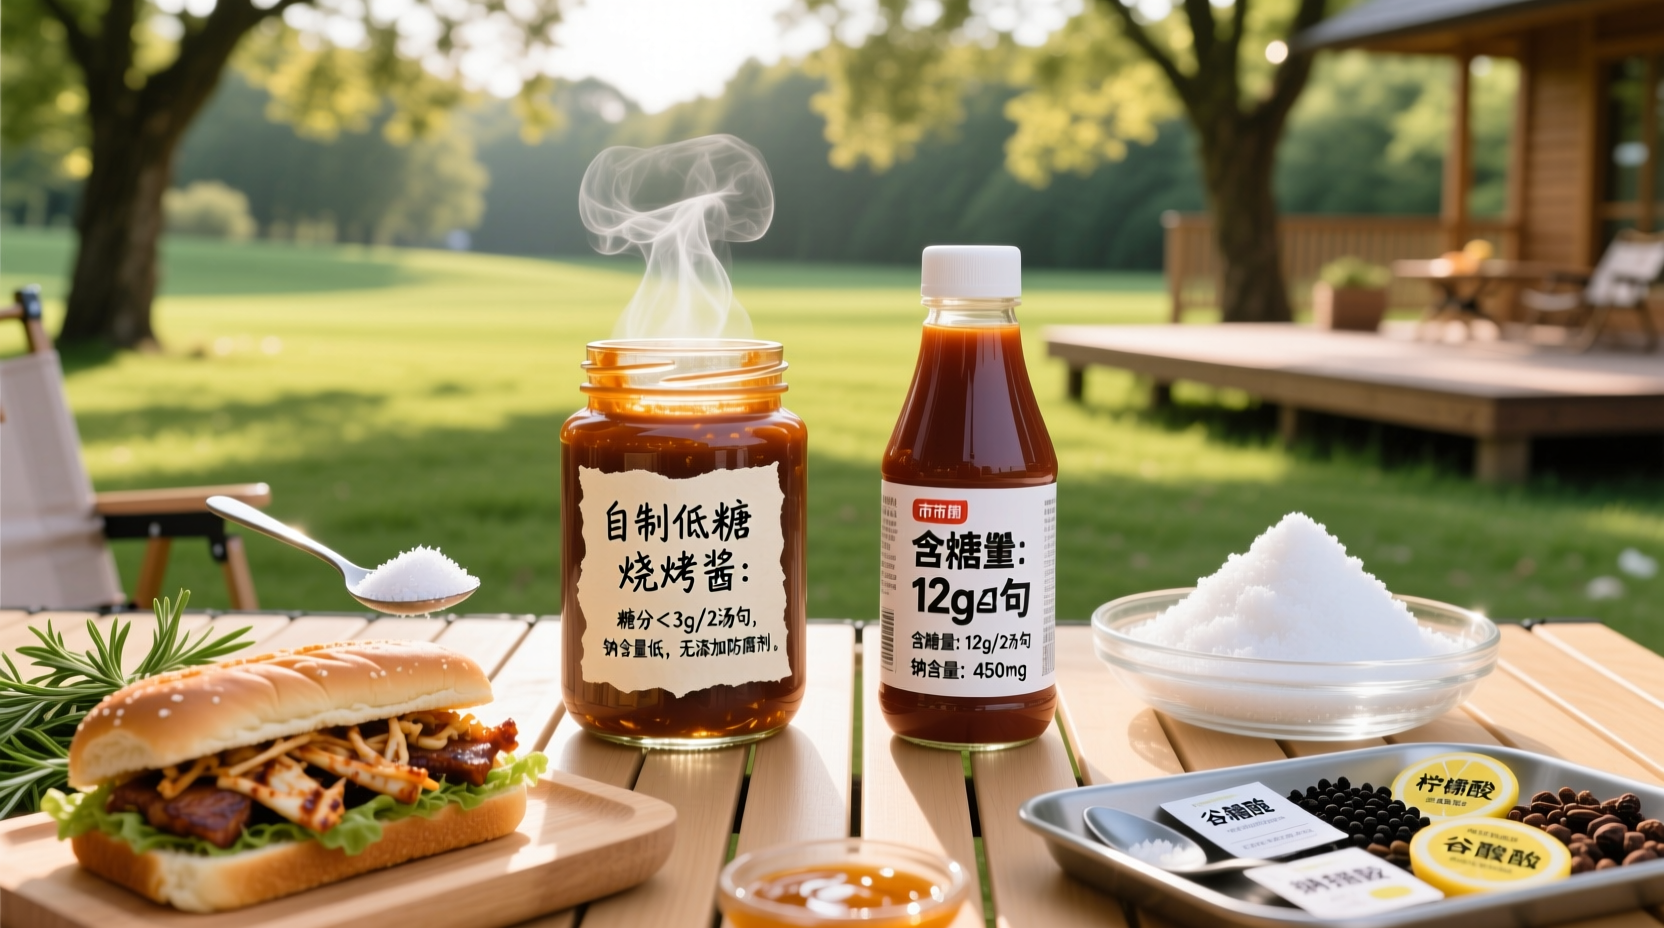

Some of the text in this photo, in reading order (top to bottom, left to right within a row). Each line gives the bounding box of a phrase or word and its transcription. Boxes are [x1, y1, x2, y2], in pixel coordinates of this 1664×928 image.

[606, 499, 752, 542] 自制低糖
[618, 549, 749, 593] 烧烤酱:
[973, 662, 1027, 682] 450mg
